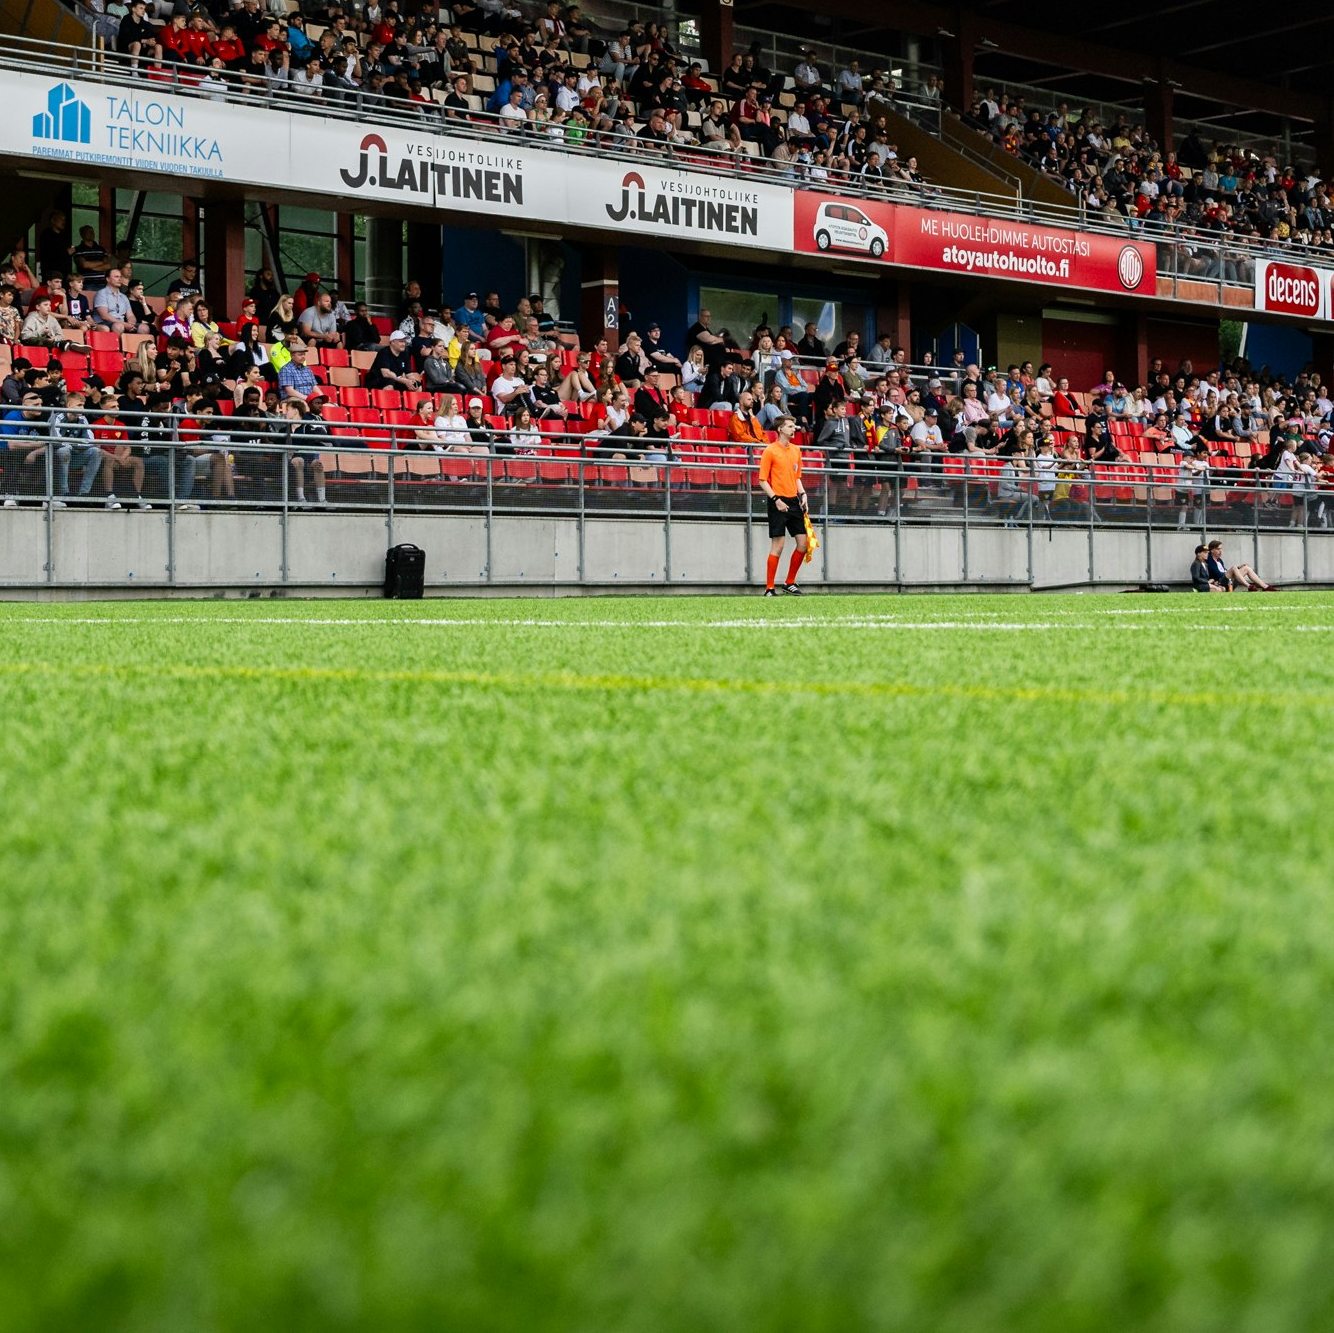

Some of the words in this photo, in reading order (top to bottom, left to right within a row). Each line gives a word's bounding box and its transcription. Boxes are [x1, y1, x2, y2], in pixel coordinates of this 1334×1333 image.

[106, 96, 184, 128] TALON
[106, 125, 223, 162] TEKNIIKKA
[406, 143, 523, 170] VESIJOHTOLIIKE
[32, 145, 74, 159] PAREMMAT
[76, 151, 134, 166] PUTKIREMONTIT
[135, 158, 158, 169] VIIDEN
[160, 162, 188, 173] VUODEN
[189, 165, 223, 178] TAKUULLA
[340, 152, 524, 205] J.LAITINEN
[661, 180, 758, 204] VESIJOHTOLIIKE
[605, 189, 758, 236] J.LAITINEN
[920, 217, 939, 235] ME
[942, 221, 1029, 248] HUOLEHDIMME
[1031, 234, 1090, 257] AUTOSTASI
[942, 245, 1069, 278] atoyautohuolto.fi
[606, 297, 616, 312] A
[1268, 269, 1316, 307] decens
[607, 313, 615, 328] 2
